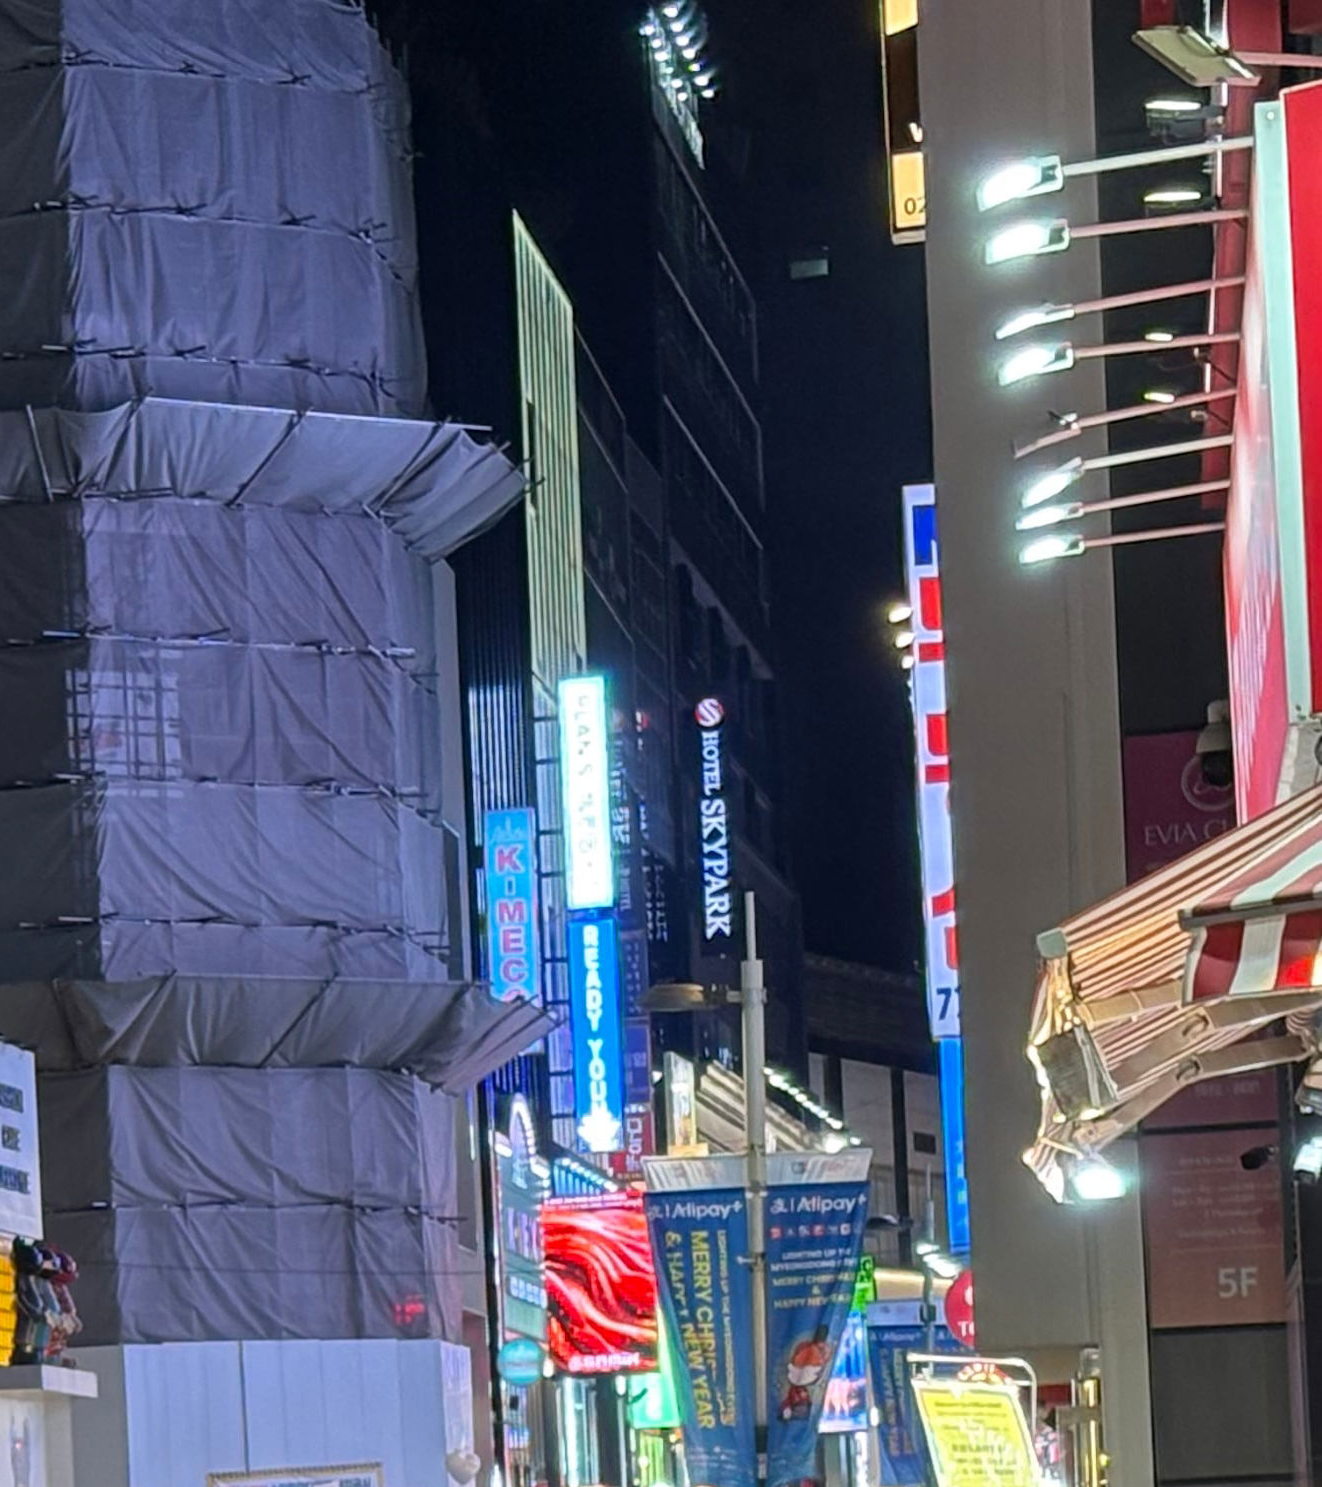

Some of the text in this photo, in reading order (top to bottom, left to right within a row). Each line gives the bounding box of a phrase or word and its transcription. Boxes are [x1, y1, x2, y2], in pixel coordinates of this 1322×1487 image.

[700, 730, 732, 941] HOTEL SKYPARK
[1144, 821, 1197, 846] EVIA
[583, 924, 600, 1032] READY
[664, 1231, 682, 1248] &
[690, 1231, 713, 1304] MERRY
[1217, 1266, 1258, 1298] 5F
[681, 1323, 706, 1370] NEW
[693, 1377, 716, 1429] YEAR
